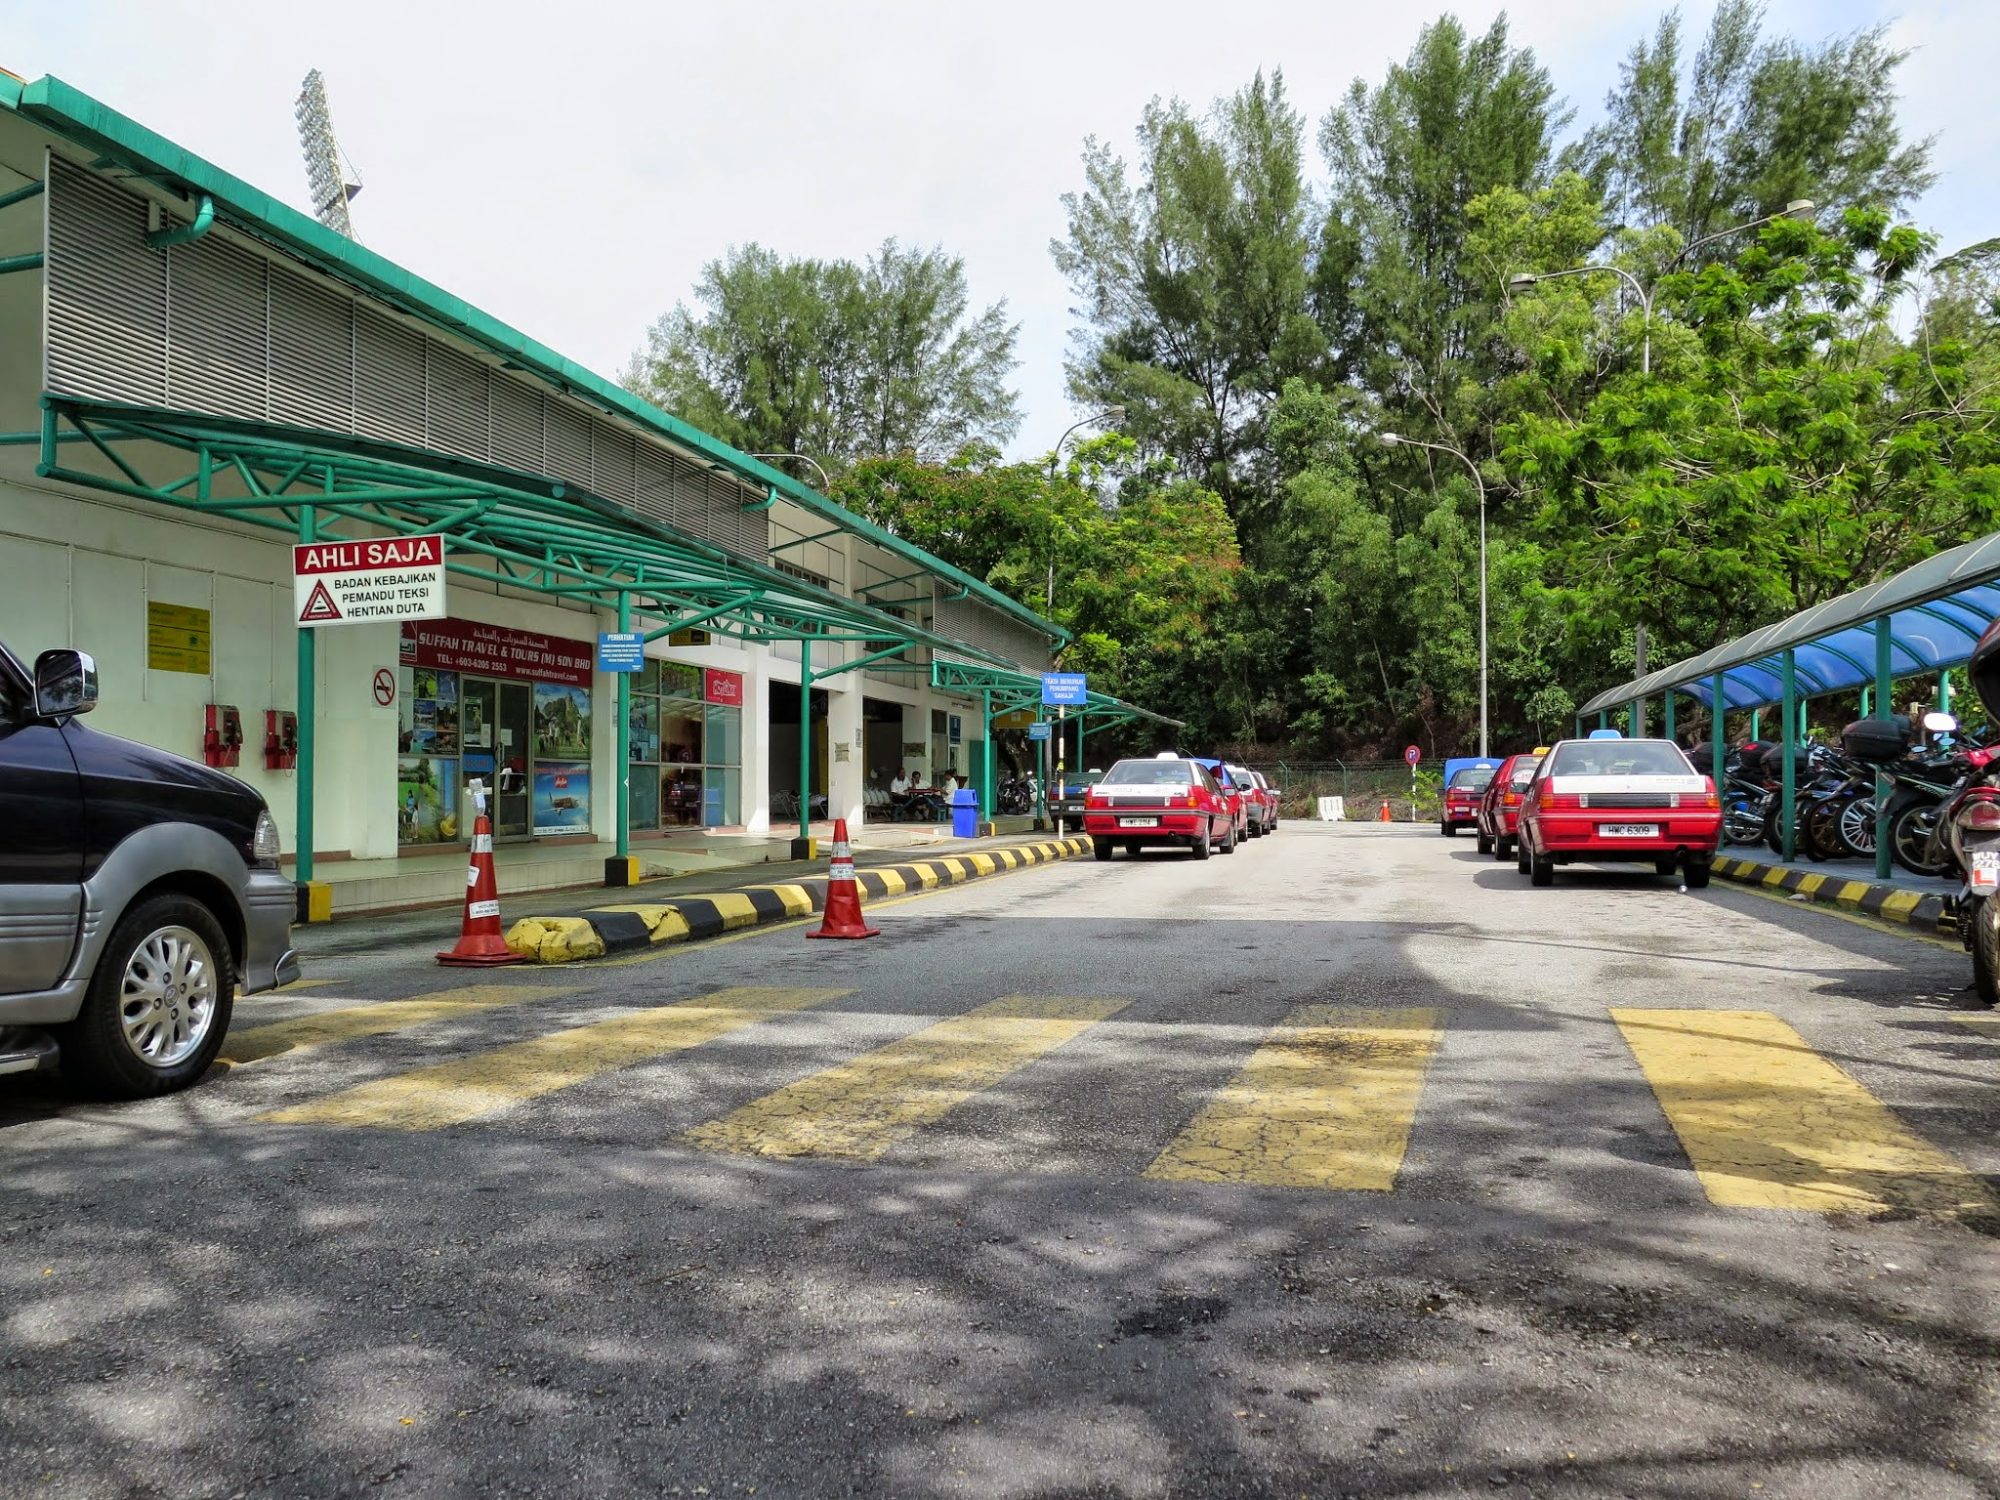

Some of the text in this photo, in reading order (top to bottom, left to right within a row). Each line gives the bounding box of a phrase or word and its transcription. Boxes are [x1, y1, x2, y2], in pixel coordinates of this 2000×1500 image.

[304, 541, 433, 569] AHLI SAJA
[334, 572, 436, 589] BADAN KEBAJIKAN
[342, 587, 429, 603] PEMANDU TEKSI
[347, 602, 425, 617] HENTIAN DUTA
[418, 632, 591, 670] SUFFAH TRAVEL & TOURS (M) SDN BHD
[437, 653, 453, 665] TEL:
[1608, 825, 1650, 835] HWC 6309
